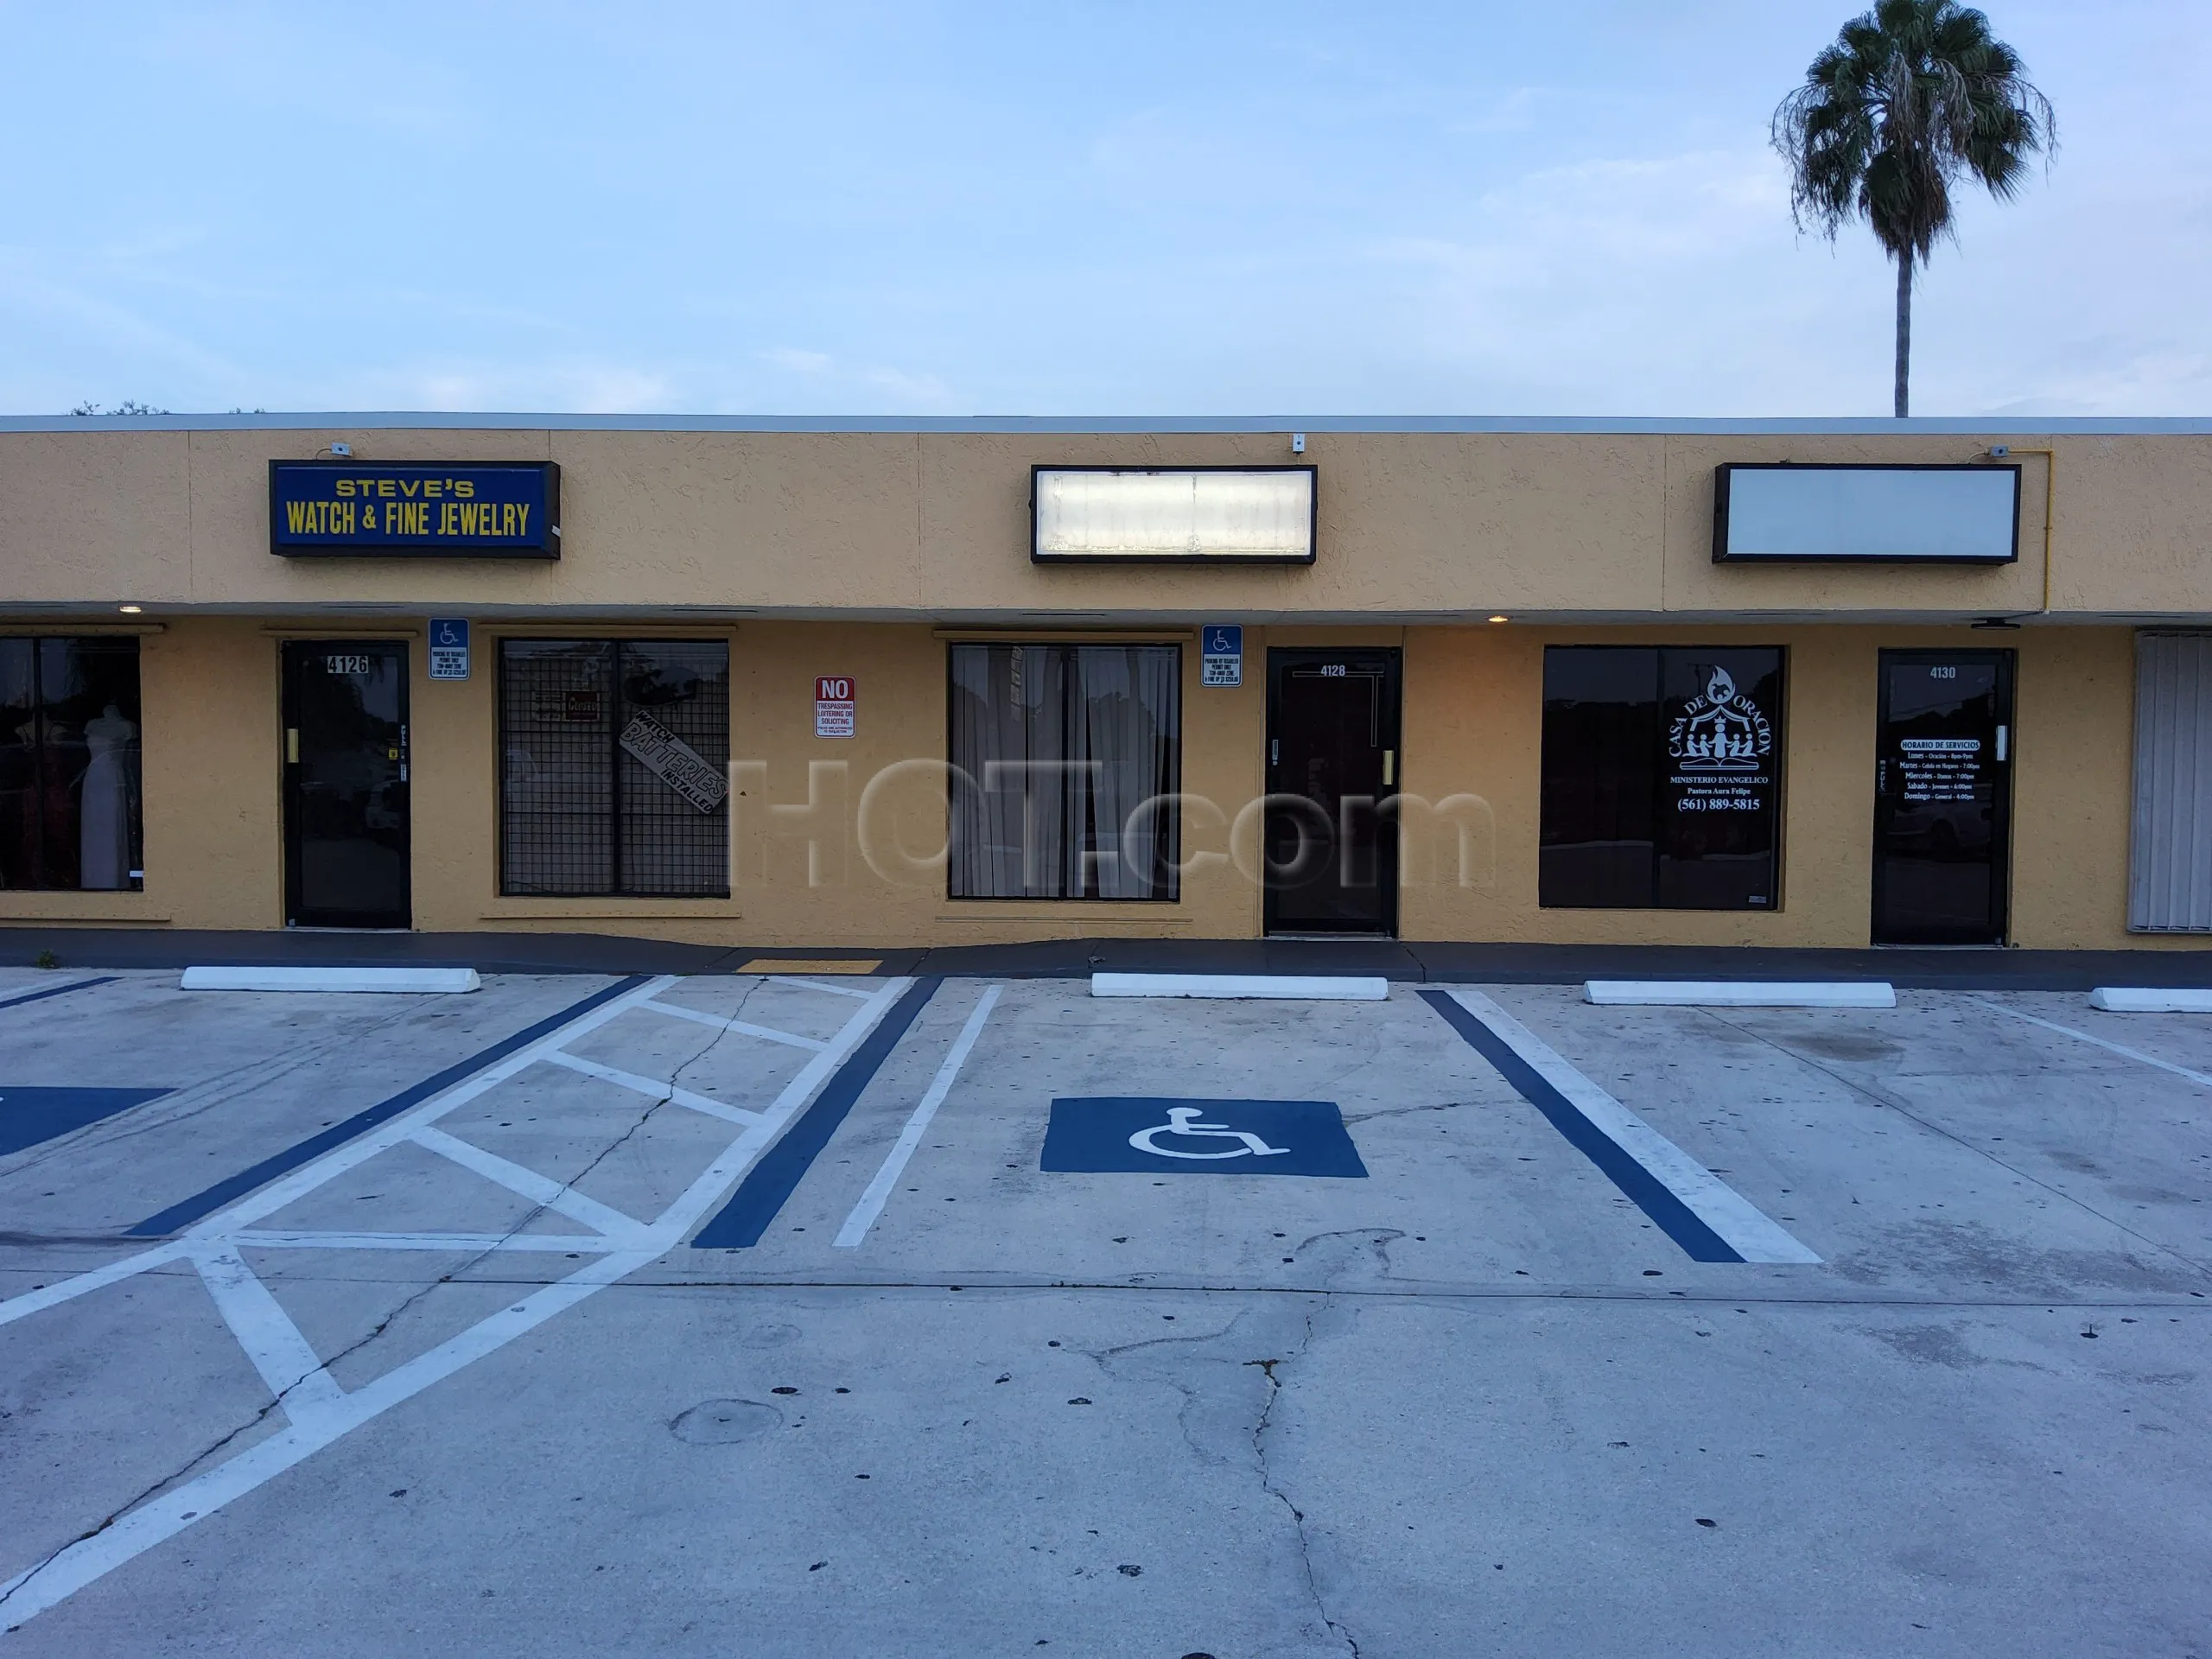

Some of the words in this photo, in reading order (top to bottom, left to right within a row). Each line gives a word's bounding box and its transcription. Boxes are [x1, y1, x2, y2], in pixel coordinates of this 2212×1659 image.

[335, 479, 474, 499] STEVE'S
[286, 501, 355, 535] WATCH
[362, 504, 377, 530] &
[385, 502, 429, 536] FINE
[436, 503, 530, 537] JEWELRY
[328, 656, 367, 673] 4126
[1320, 664, 1346, 677] 4128
[1929, 666, 1956, 679] 4130
[822, 679, 849, 699] NO
[635, 711, 675, 743] WATCH
[1669, 717, 1688, 757] CASA
[1683, 694, 1708, 715] DE
[1732, 695, 1772, 756] ORACION
[620, 721, 729, 799] BATTERIES
[660, 769, 714, 812] INSTALLED
[1731, 788, 1751, 796] Felipe
[1904, 792, 1931, 801] Domingo
[1677, 798, 1707, 812] (561)
[1709, 798, 1760, 810] 889-5815
